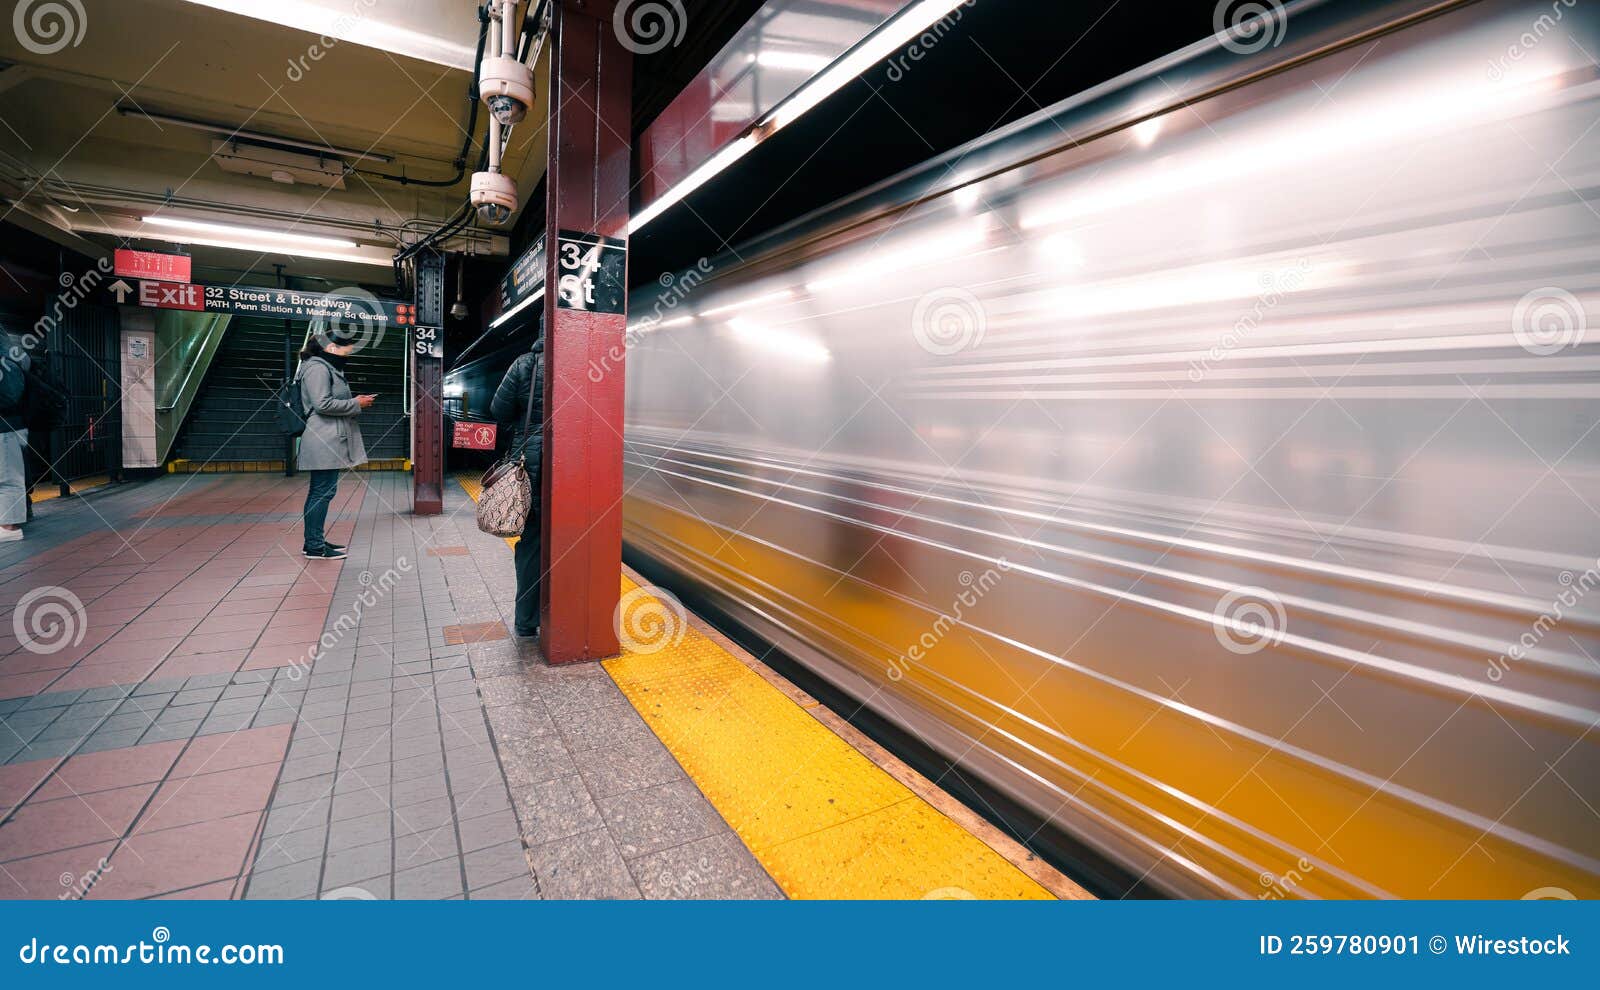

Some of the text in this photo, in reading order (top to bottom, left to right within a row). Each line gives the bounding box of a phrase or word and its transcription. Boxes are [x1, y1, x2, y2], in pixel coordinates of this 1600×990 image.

[560, 243, 602, 273] 34
[140, 280, 197, 306] Exit
[205, 287, 352, 311] 32 Street & Broadway
[560, 274, 595, 304] St
[205, 299, 389, 321] PATH Penn Station & Madison Sq Garden
[416, 327, 436, 340] 34
[416, 341, 433, 354] St
